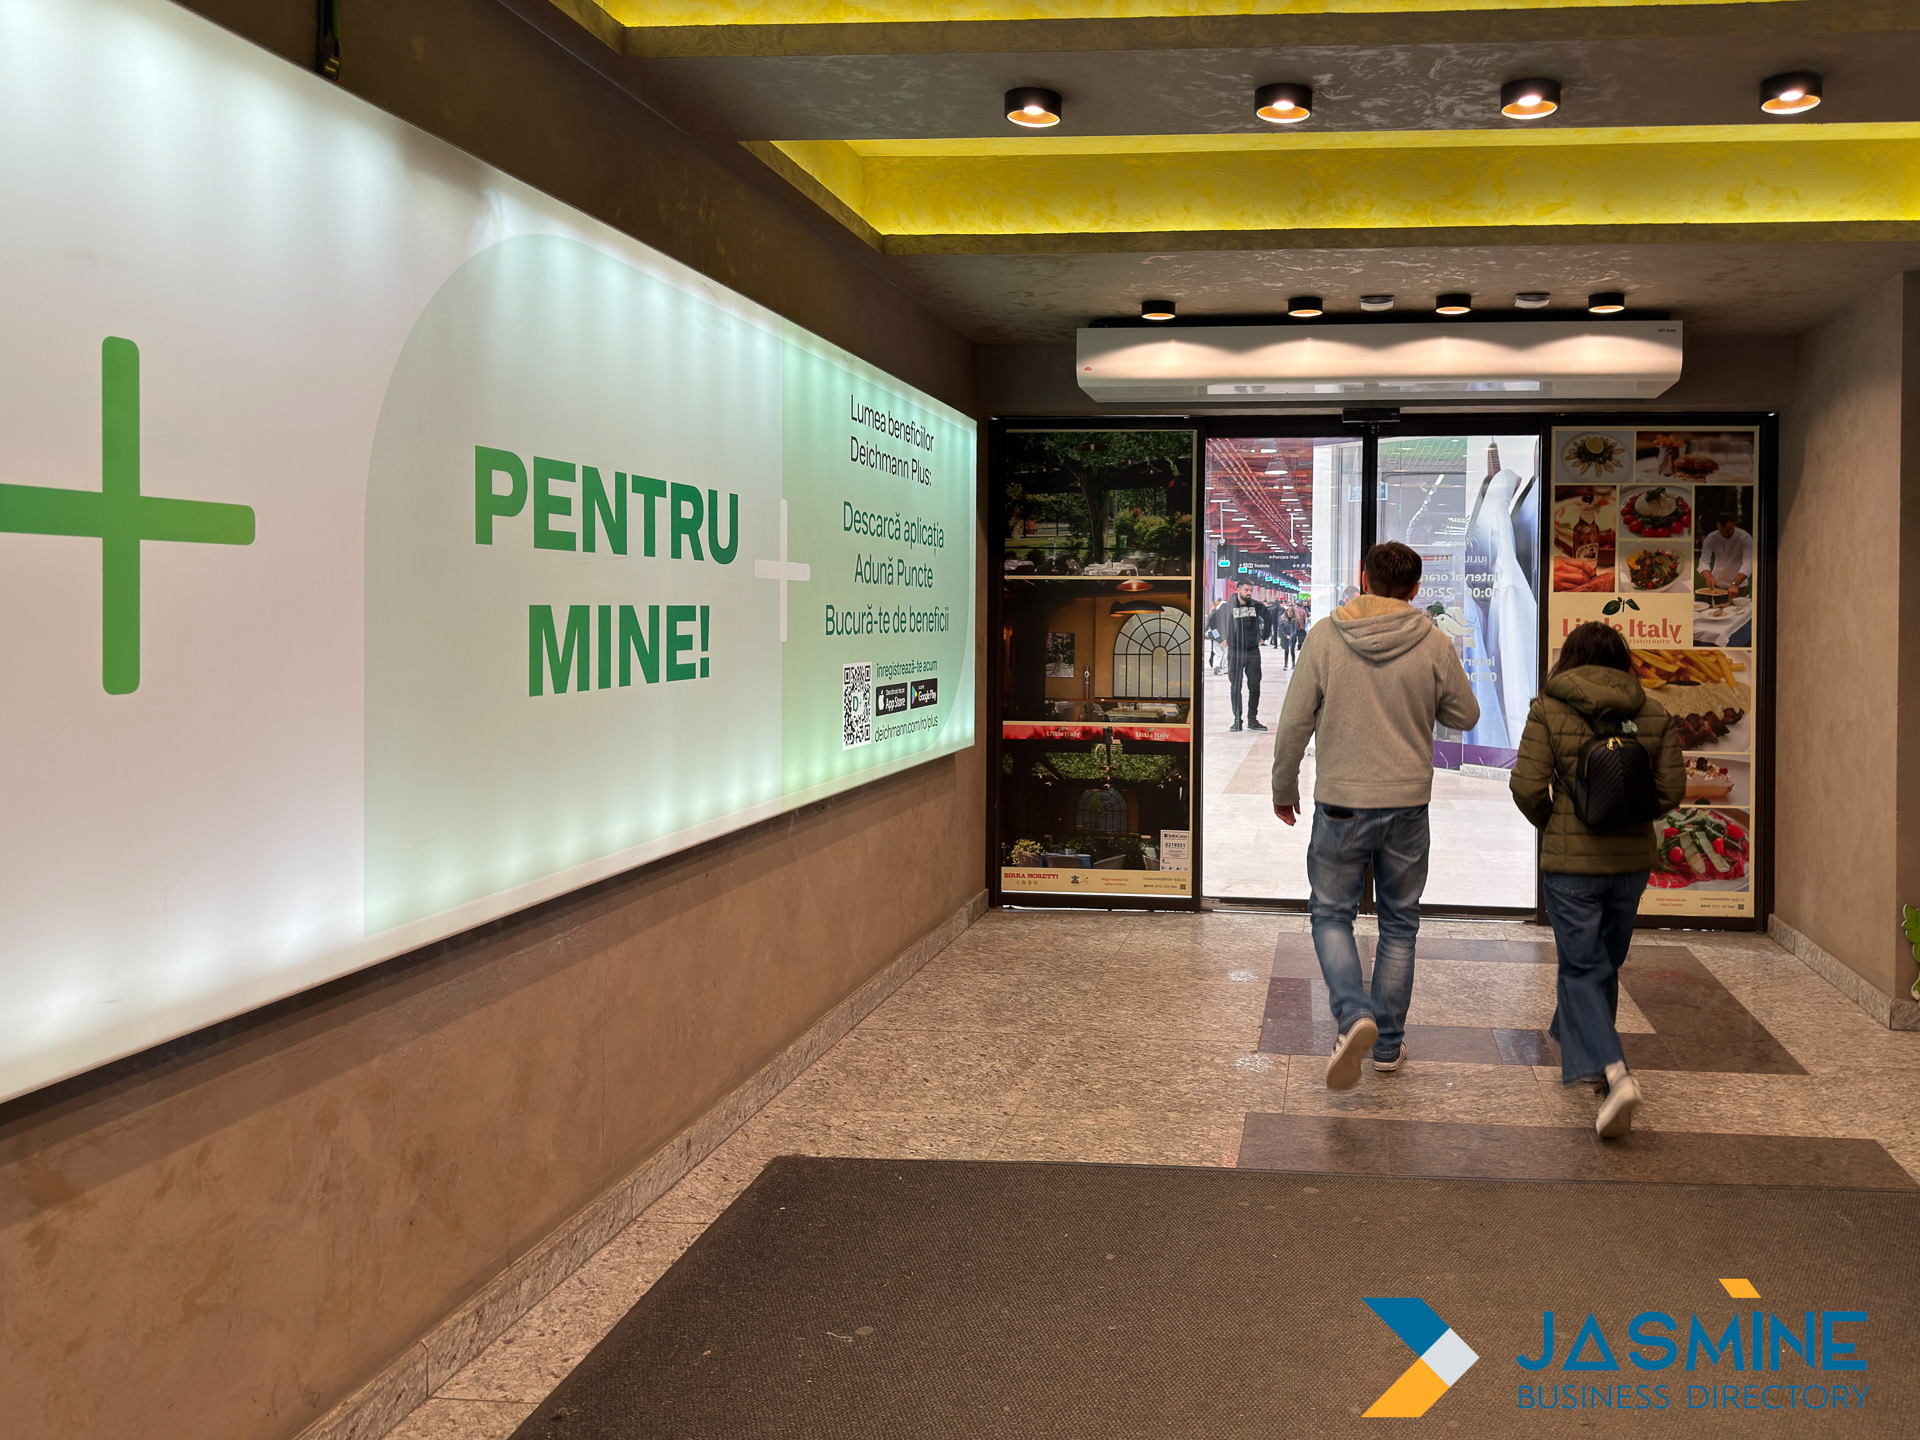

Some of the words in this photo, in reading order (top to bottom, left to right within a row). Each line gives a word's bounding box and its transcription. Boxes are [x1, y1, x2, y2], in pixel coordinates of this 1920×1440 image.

[850, 394, 886, 434] Lumea
[888, 410, 934, 452] beneficiilor
[850, 436, 909, 479] Deichmann
[912, 458, 932, 486] Plus:
[475, 445, 739, 565] PENTRU
[843, 501, 901, 541] Descarcă
[904, 517, 944, 556] aplicația
[854, 553, 894, 585] Adună
[897, 559, 934, 588] Puncte
[825, 604, 890, 636] Bucură-te
[893, 605, 907, 634] de
[909, 605, 949, 633] beneficii
[1629, 618, 1682, 644] Italy
[528, 604, 710, 697] MINE!
[923, 660, 938, 672] acum
[886, 698, 895, 712] App
[895, 696, 906, 708] Store
[918, 690, 930, 703] Google
[929, 689, 937, 702] Play
[1065, 730, 1081, 738] Italy
[1154, 731, 1170, 739] Italy
